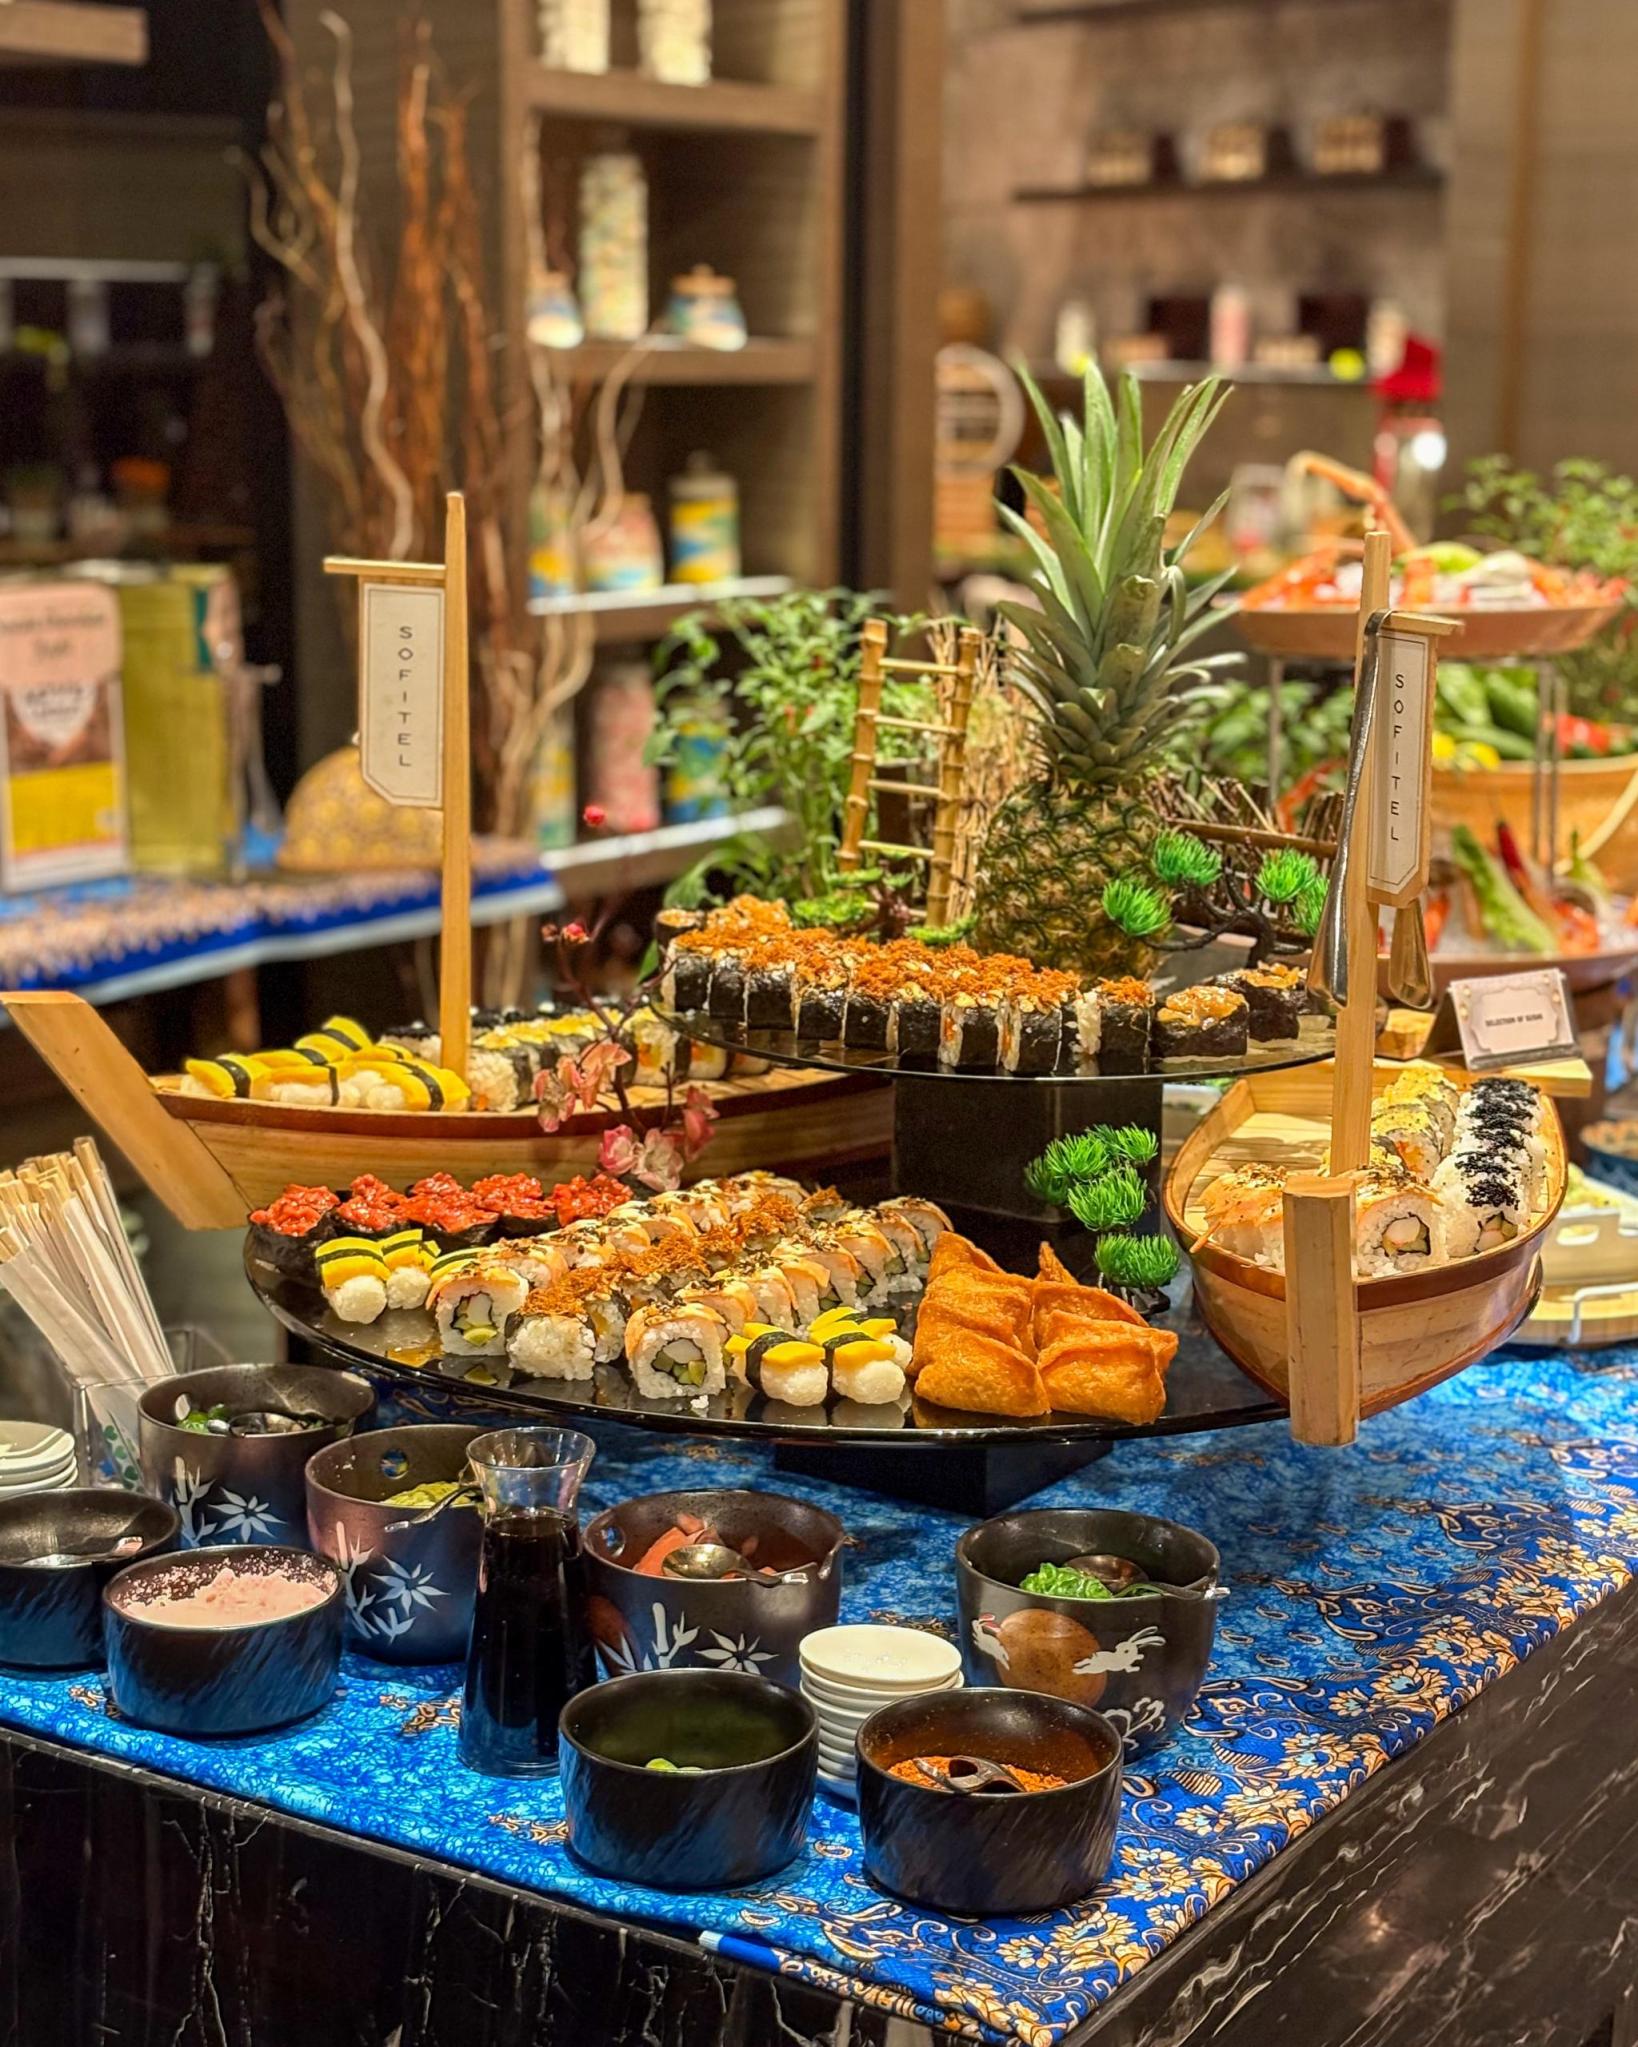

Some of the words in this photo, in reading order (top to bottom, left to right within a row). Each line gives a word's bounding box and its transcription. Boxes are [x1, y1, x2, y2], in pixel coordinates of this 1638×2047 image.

[397, 625, 414, 767] SOFITEL
[1390, 673, 1405, 841] SOFITEL
[1485, 1017, 1515, 1027] SELECTION
[1516, 1015, 1524, 1023] OF
